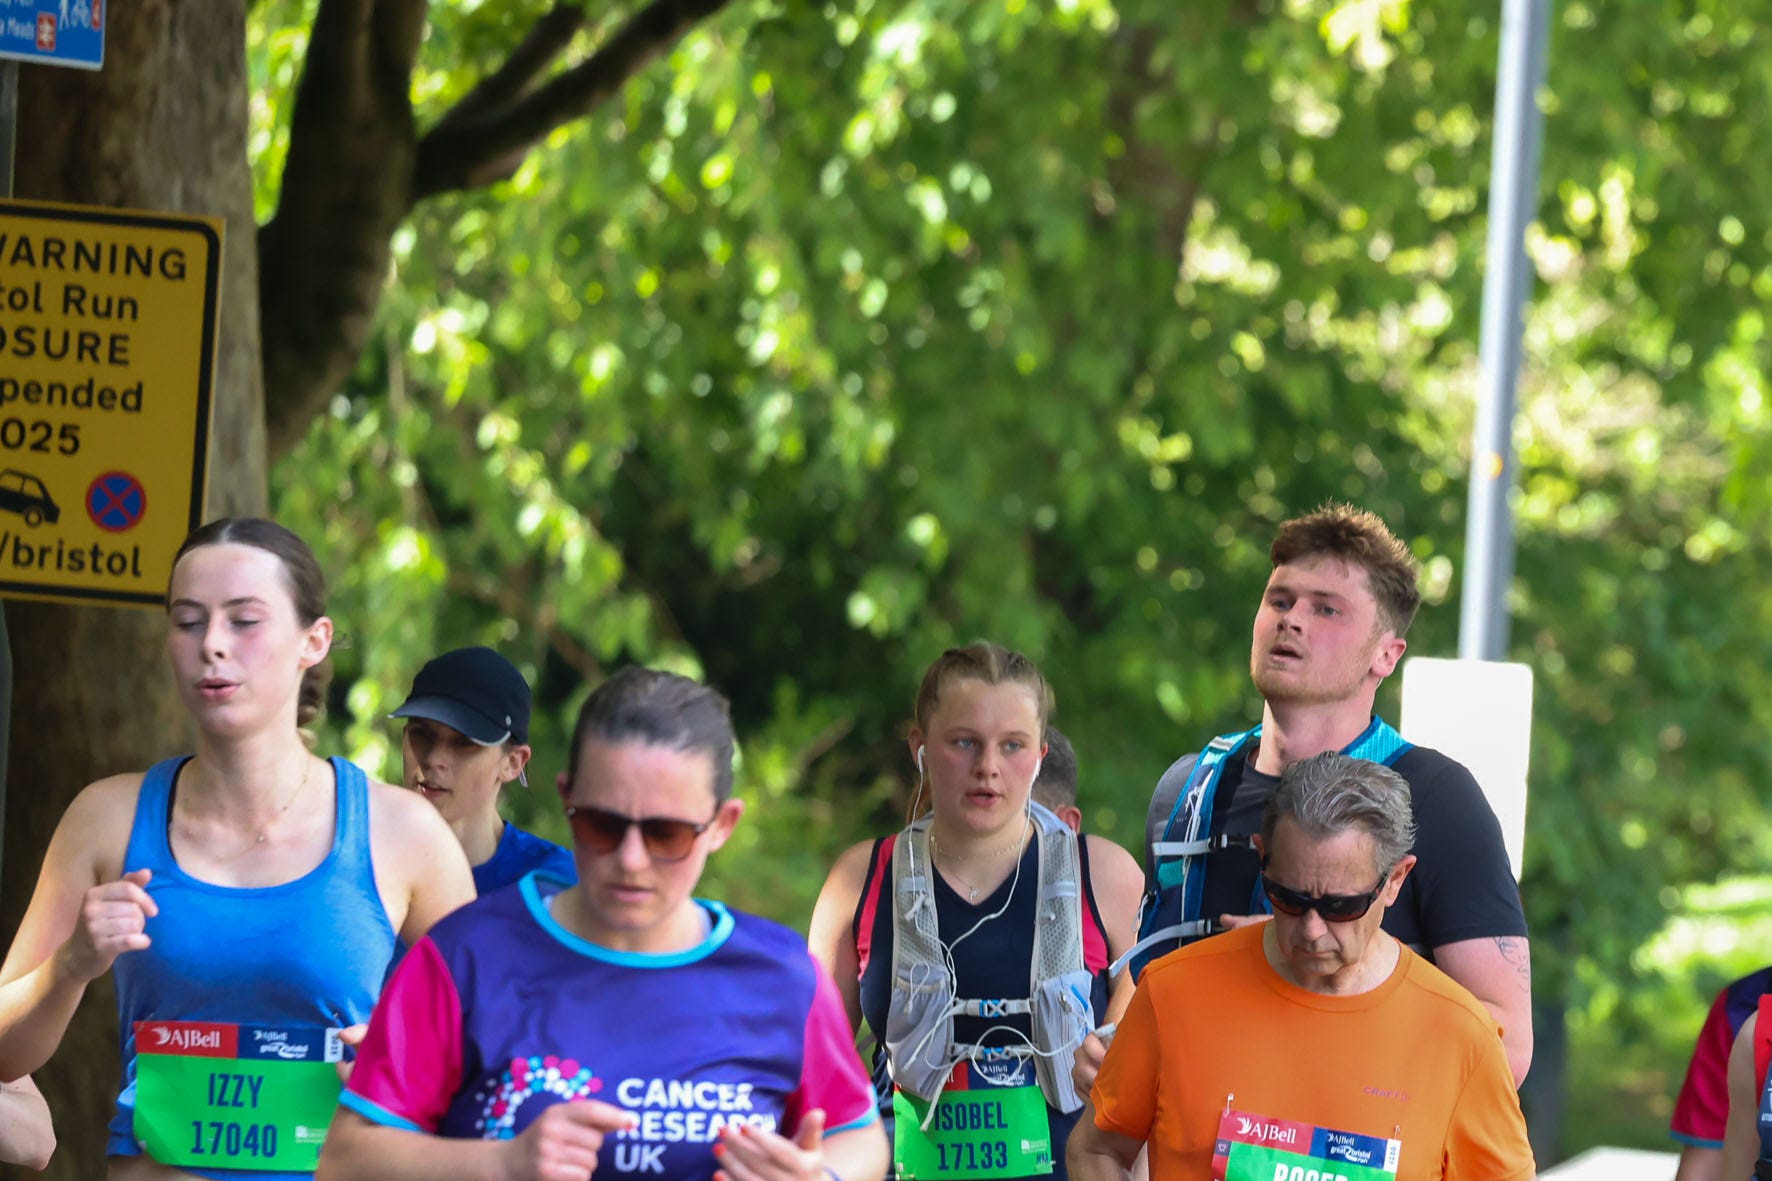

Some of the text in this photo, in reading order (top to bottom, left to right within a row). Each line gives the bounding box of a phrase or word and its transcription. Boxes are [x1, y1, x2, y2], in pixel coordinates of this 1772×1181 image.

[63, 284, 139, 321] Run
[208, 1073, 264, 1108] IZZY
[616, 1078, 754, 1111] CANCER
[934, 1101, 1008, 1131] ISOBEL
[191, 1121, 278, 1158] 17040
[1250, 1122, 1297, 1144] AJBell
[614, 1143, 667, 1174] UK
[937, 1141, 1008, 1171] 17133
